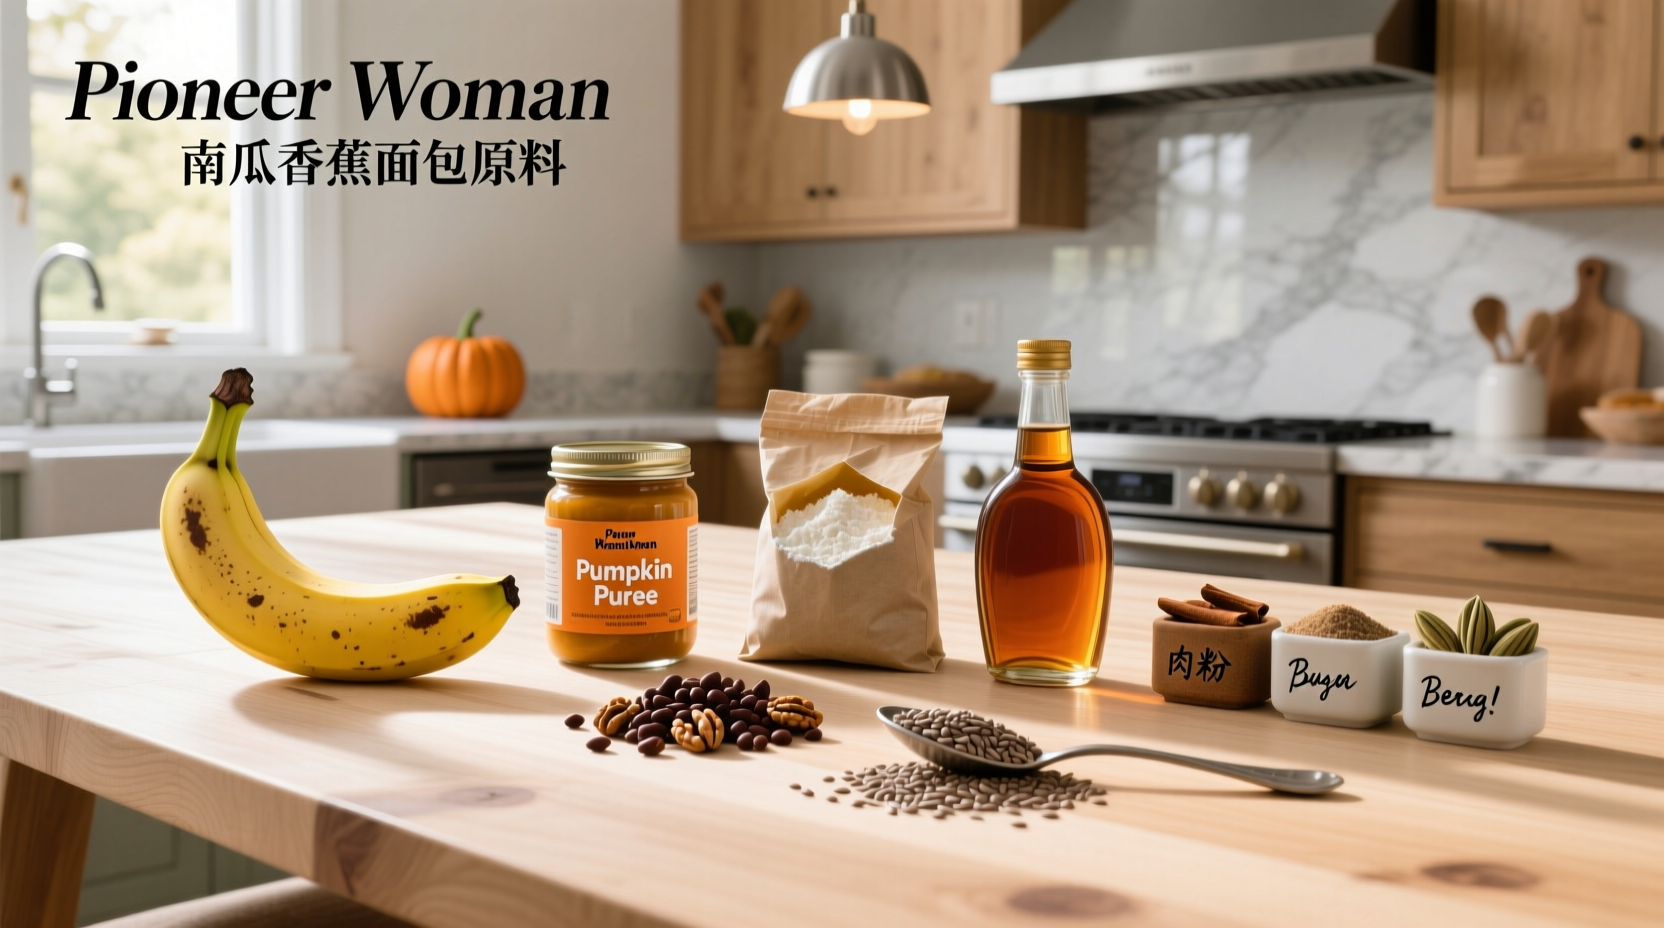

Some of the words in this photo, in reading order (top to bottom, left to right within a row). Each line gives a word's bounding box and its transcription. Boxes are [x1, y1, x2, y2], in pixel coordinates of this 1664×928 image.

[576, 558, 673, 586] Pumpkin
[594, 585, 658, 606] Puree
[1168, 644, 1233, 684] 肉粉
